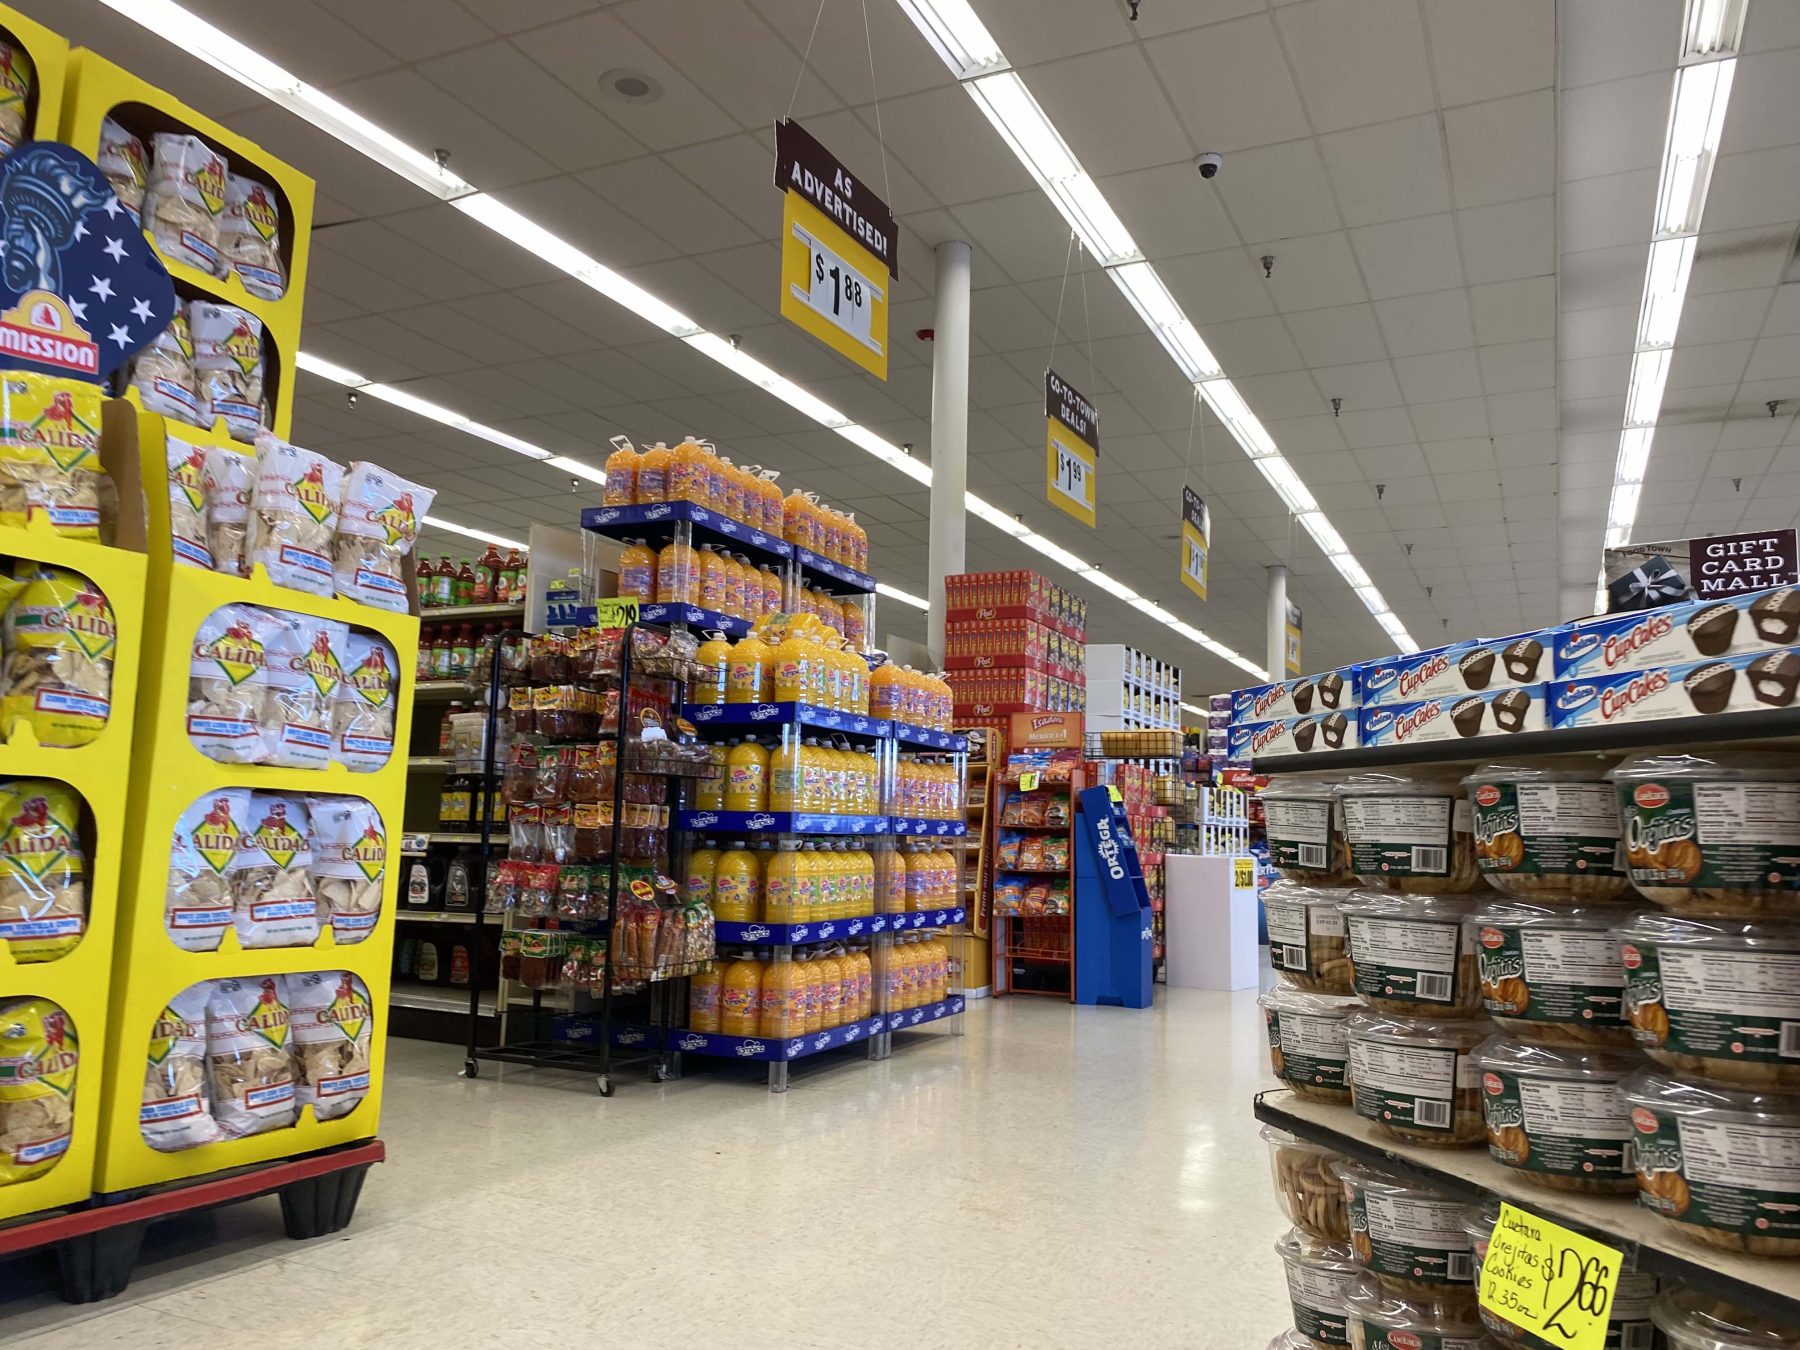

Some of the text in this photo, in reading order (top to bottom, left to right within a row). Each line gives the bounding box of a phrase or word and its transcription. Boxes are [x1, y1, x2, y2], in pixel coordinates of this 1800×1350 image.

[834, 168, 853, 199] AS
[791, 160, 888, 256] ADVERTISED!
[1051, 375, 1096, 425] GO-TO-TOWN
[1061, 403, 1087, 436] DEALS!
[18, 427, 98, 449] CALIDA
[1706, 538, 1779, 558] GIFT
[1701, 556, 1785, 576] CARD
[1701, 573, 1789, 592] MALL
[194, 643, 267, 667] CALIDA
[1603, 613, 1674, 669] CupCakes
[289, 657, 345, 682] CALIDA
[1399, 653, 1449, 697] CupCakes
[1254, 685, 1286, 719] CupCakes
[1600, 668, 1669, 720] CupCakes
[1252, 720, 1286, 754] CupCakes
[1395, 701, 1441, 741] CupCakes
[1096, 816, 1125, 880] ORTEGA
[741, 929, 770, 942] Tampico
[316, 1004, 371, 1025] CALIDA
[1485, 1253, 1533, 1290] Cookies
